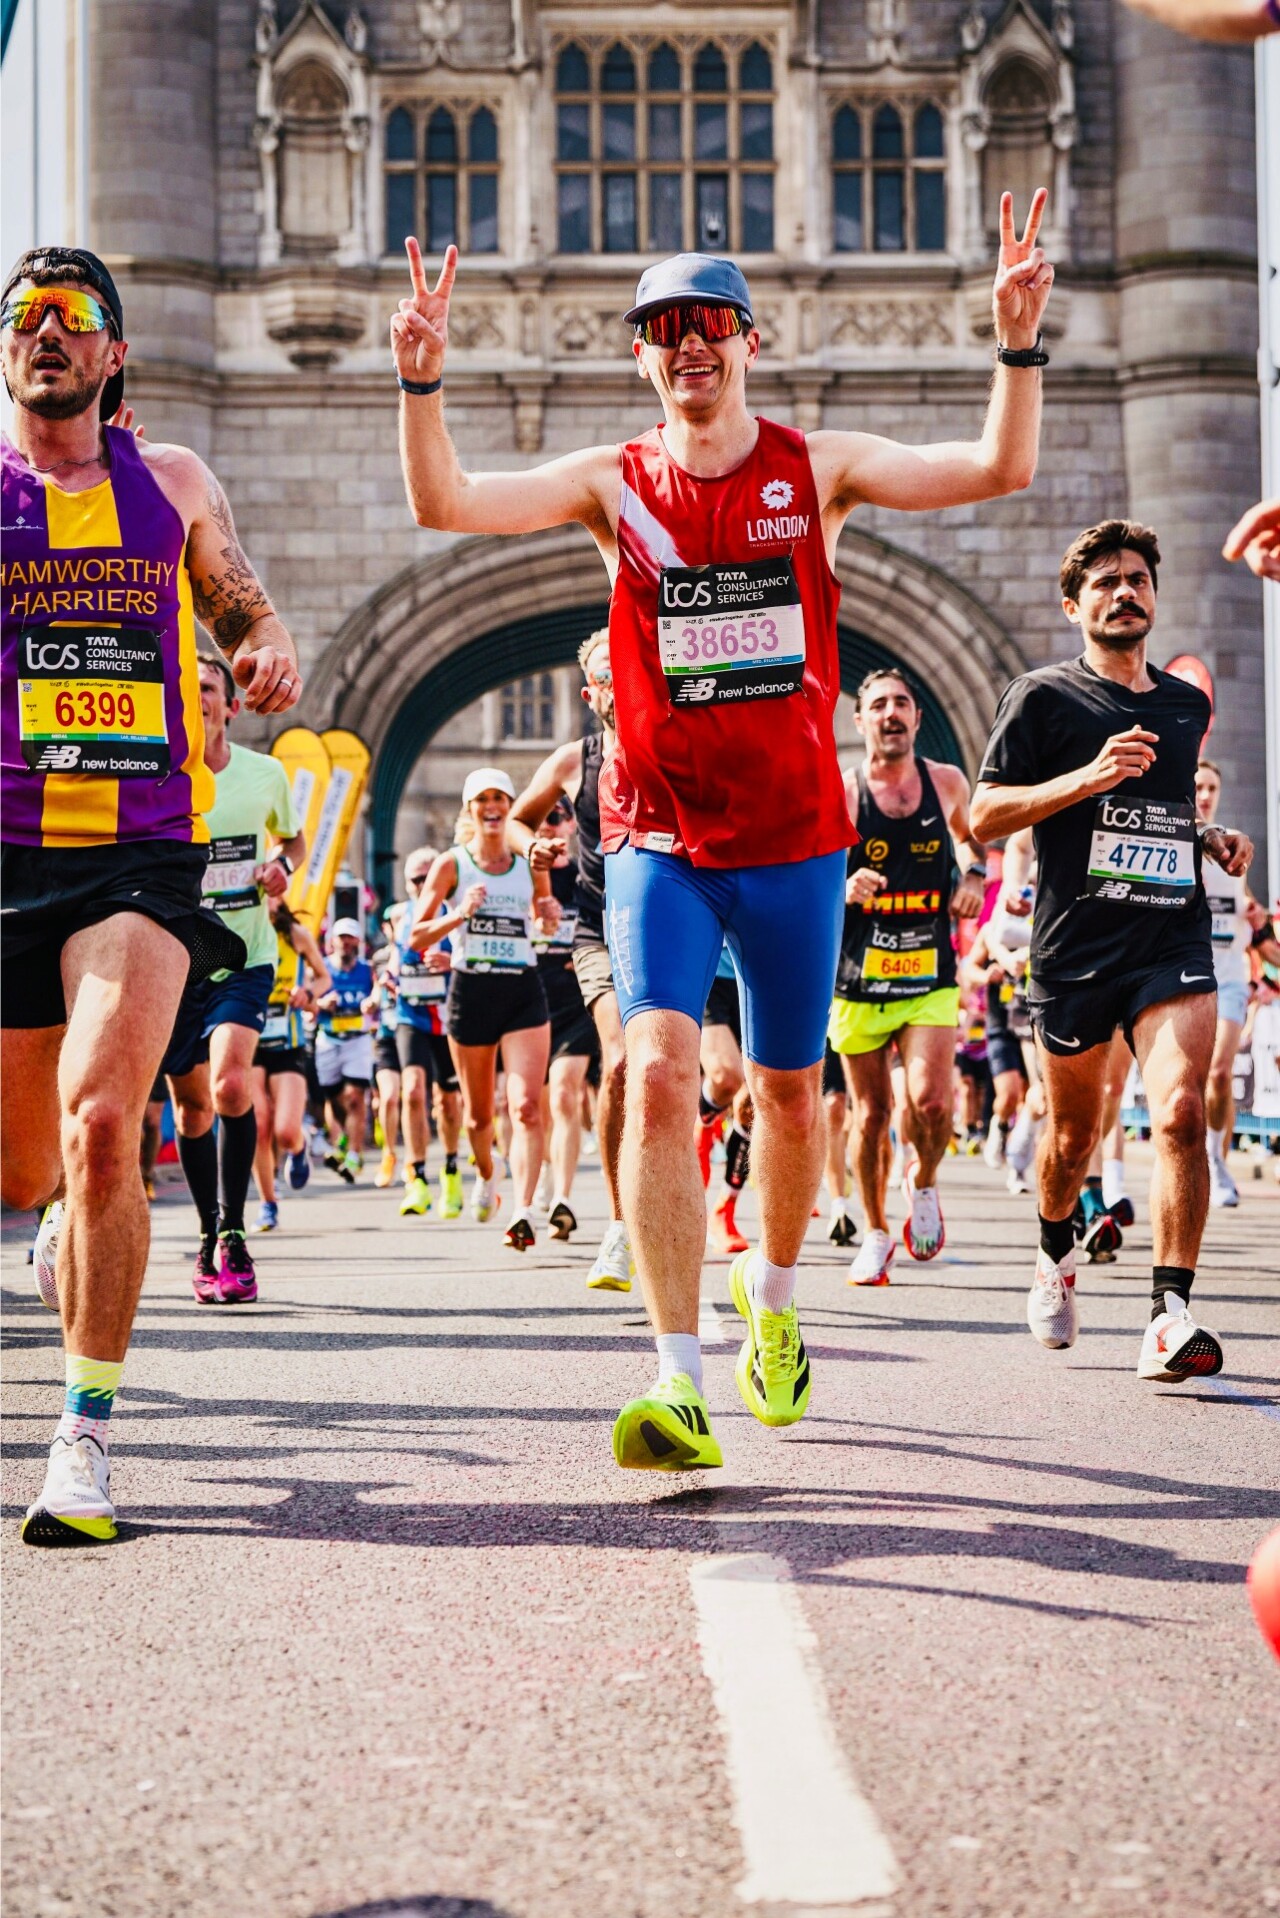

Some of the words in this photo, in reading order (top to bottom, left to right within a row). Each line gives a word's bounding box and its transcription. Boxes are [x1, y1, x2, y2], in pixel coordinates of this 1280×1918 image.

[747, 515, 810, 542] LONDON
[716, 572, 748, 581] TATA
[716, 576, 790, 592] CONSULTANCY
[664, 576, 712, 608] tcs
[718, 590, 764, 604] SERVICES
[10, 590, 158, 614] HARRIERS
[85, 636, 118, 646] TATA
[682, 619, 779, 661] 38653
[26, 636, 80, 670] tcs
[86, 648, 156, 662] CONSULTANCY
[86, 660, 132, 672] SERVICES
[718, 688, 742, 699] new
[746, 682, 795, 696] balance
[55, 691, 135, 728] 6399
[82, 760, 107, 770] new
[110, 758, 158, 771] balance
[1102, 801, 1141, 829] tcs
[1146, 806, 1167, 815] TATA
[1144, 823, 1176, 833] SERVICES
[1145, 814, 1191, 826] CONSULTANCY
[1108, 843, 1178, 874] 47778
[202, 867, 250, 889] 8162
[862, 890, 940, 914] MIKI
[1130, 894, 1148, 903] new
[1150, 895, 1186, 905] balance
[872, 929, 898, 950] tcs
[482, 942, 515, 957] 1856
[882, 958, 920, 975] 6406
